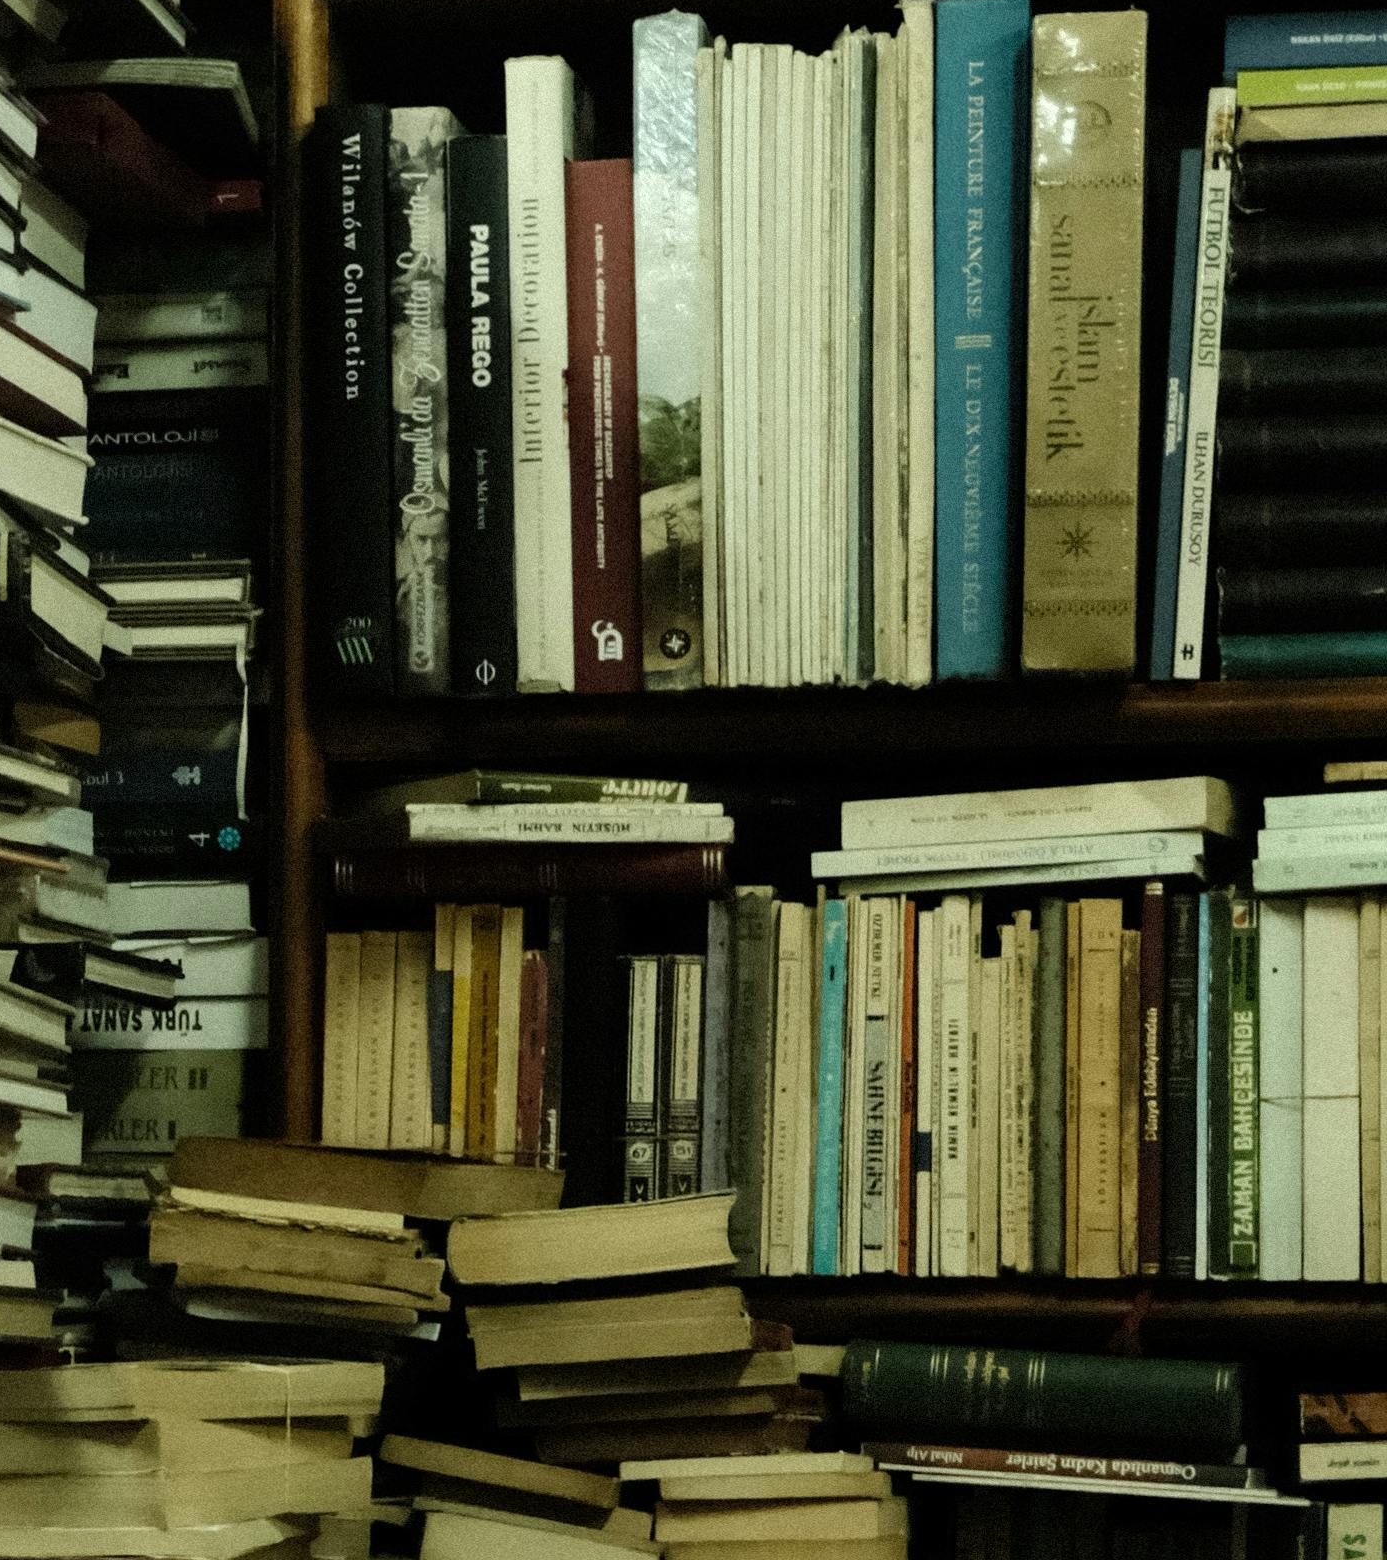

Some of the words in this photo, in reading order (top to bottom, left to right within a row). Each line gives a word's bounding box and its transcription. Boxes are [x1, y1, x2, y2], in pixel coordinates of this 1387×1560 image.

[968, 61, 984, 88] LA
[966, 95, 985, 198] PEINTURE
[341, 133, 365, 251] Wilanów
[1201, 188, 1228, 269] FUTBOL
[468, 224, 491, 308] PAULA
[516, 197, 540, 344] Decoration
[342, 263, 366, 401] Collection
[469, 316, 492, 388] REGO
[518, 357, 542, 464] Interior
[965, 364, 983, 390] LE
[1230, 1010, 1256, 1151] BAHÇESİNDE
[1232, 1160, 1253, 1236] ZAMAN
[1059, 1454, 1108, 1474] Kadın
[1111, 1457, 1196, 1482] Osmanlıda
